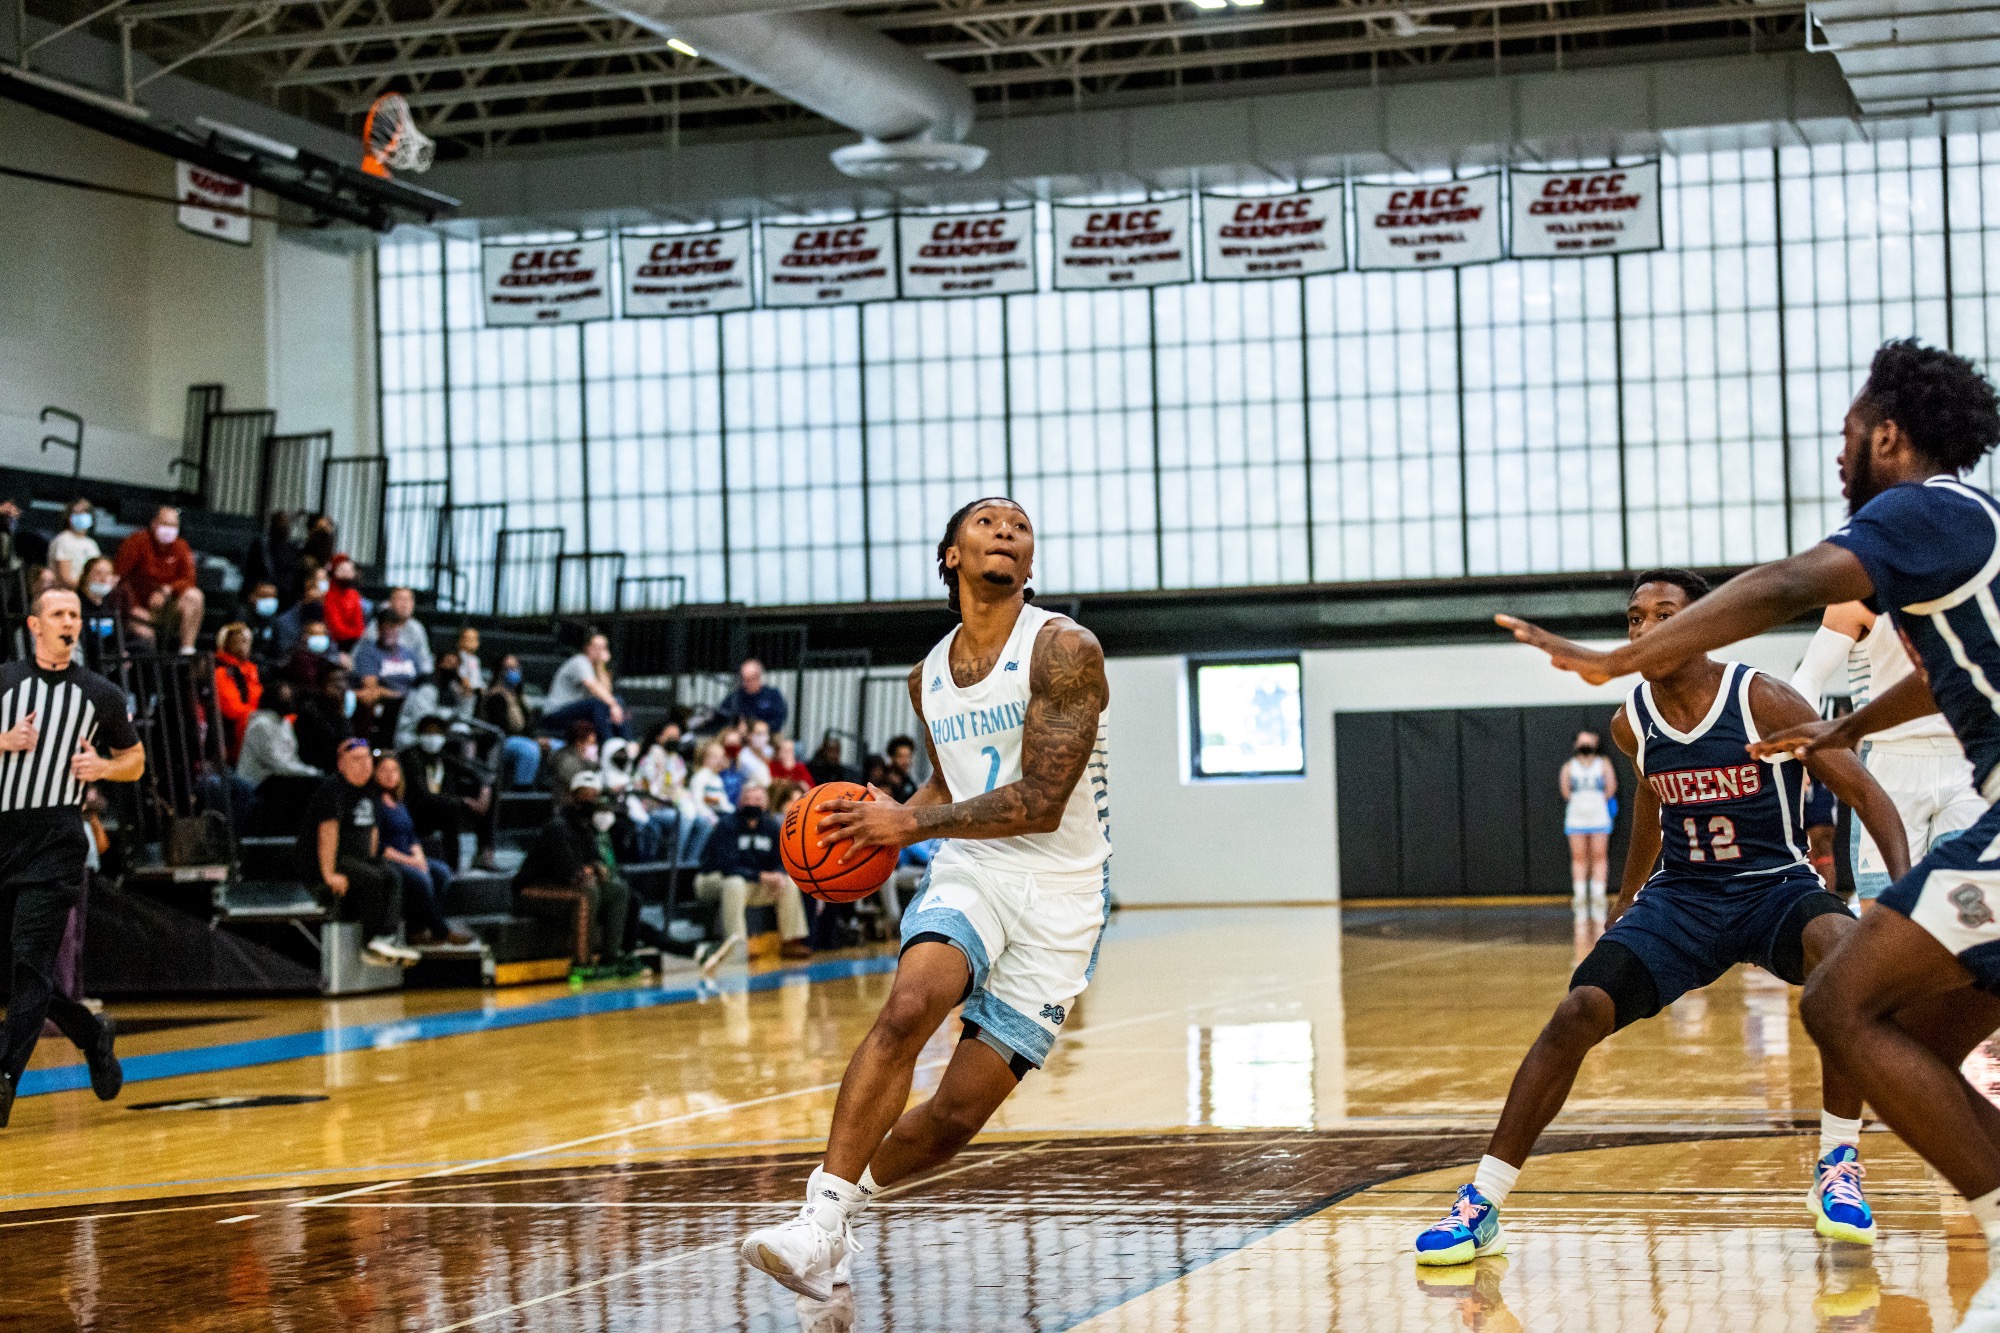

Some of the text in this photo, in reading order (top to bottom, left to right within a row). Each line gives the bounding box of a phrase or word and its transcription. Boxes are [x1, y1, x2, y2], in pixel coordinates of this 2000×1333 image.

[1542, 173, 1627, 198] CACC
[1388, 186, 1469, 211] CACC
[1528, 194, 1641, 215] CHAMPION
[1086, 209, 1162, 232] CACC
[1233, 199, 1313, 222] CACC
[1374, 205, 1483, 228] CHAMPION
[793, 227, 867, 250] CACC
[931, 218, 1006, 240] CACC
[511, 249, 582, 271] CACC
[649, 238, 722, 262] CACC
[931, 700, 1026, 745] HOLY FAMILY
[1683, 815, 1742, 862] 12
